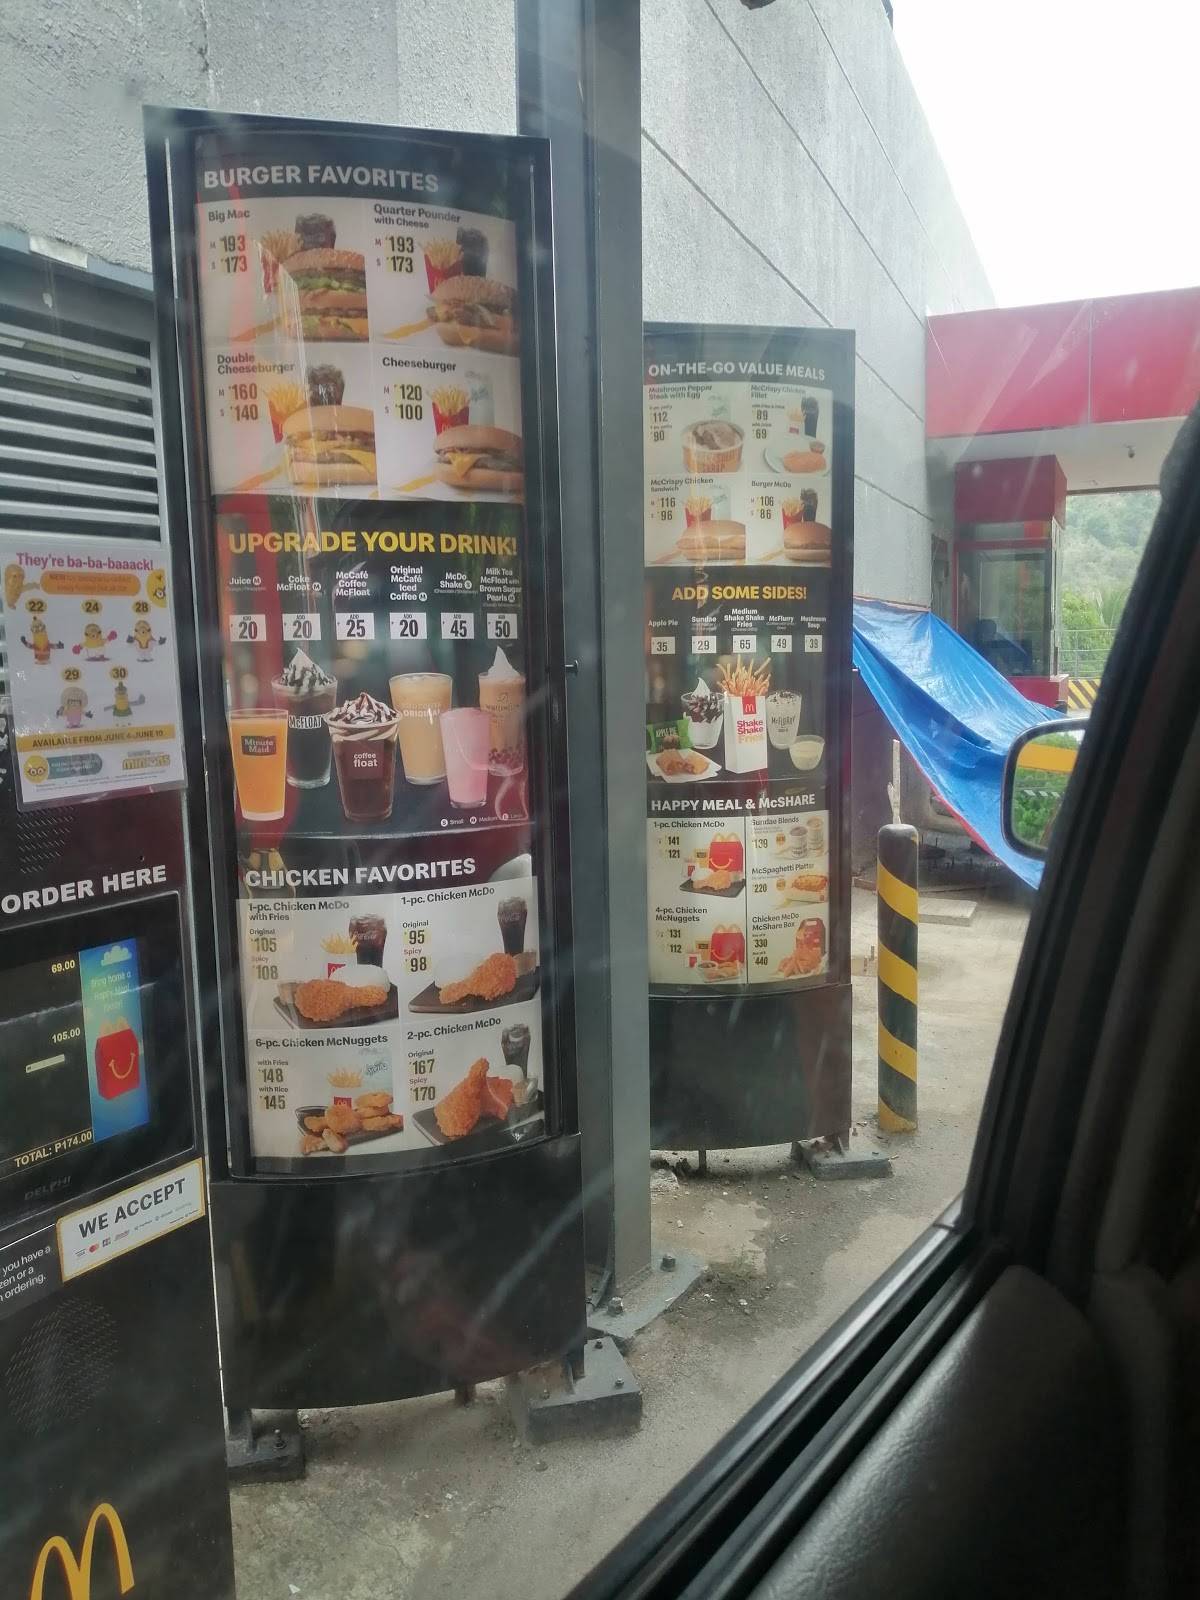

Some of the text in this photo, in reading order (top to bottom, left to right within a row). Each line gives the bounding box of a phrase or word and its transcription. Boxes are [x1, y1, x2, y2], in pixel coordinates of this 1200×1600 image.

[204, 165, 439, 192] BURGER FAVORITES
[208, 209, 250, 223] Big Mac
[373, 204, 461, 223] Quarter Pounder
[374, 216, 430, 229] with Cheese
[222, 235, 247, 251] 193
[388, 237, 414, 253] 193
[224, 256, 248, 273] 173
[390, 257, 413, 273] 173
[217, 353, 255, 364] Double
[382, 357, 457, 372] Cheeseburger
[218, 362, 295, 375] Cheeseburger
[648, 362, 825, 380] ON-THE-GO VALUE MEALS
[232, 383, 258, 400] 160
[399, 384, 422, 401] 120
[234, 405, 259, 421] 140
[399, 405, 423, 421] 100
[653, 412, 668, 422] 112
[651, 477, 714, 488] McCrispy Chicken
[751, 480, 773, 489] Burger
[660, 497, 675, 508] 116
[660, 511, 673, 521] 96
[229, 532, 518, 555] UPGRADE YOUR DRINK!
[17, 552, 154, 571] They're ba-ba-baaack!
[336, 571, 369, 580] McCafé
[390, 566, 423, 575] Original
[446, 572, 467, 580] McDo
[486, 568, 513, 576] Milk Tea
[229, 576, 251, 585] Juice
[288, 575, 310, 583] Coke
[339, 579, 367, 588] Coffee
[391, 574, 422, 583] McCafé
[480, 576, 508, 584] McFloat
[277, 583, 310, 591] McFloat
[399, 583, 417, 592] Iced
[440, 581, 463, 589] Shake
[336, 588, 370, 597] McFloat
[390, 592, 417, 601] Coffee
[487, 594, 507, 602] Pearls
[672, 586, 807, 601] ADD SOME SIDES!
[28, 601, 45, 613] 22
[85, 602, 99, 613] 24
[135, 602, 149, 613] 28
[648, 619, 666, 627] Apple
[769, 615, 794, 623] McFlurry
[239, 621, 258, 639] 20
[293, 620, 312, 638] 20
[346, 619, 366, 637] 25
[400, 620, 419, 637] 20
[450, 620, 468, 637] 45
[495, 621, 511, 638] 50
[656, 641, 668, 652] 35
[697, 640, 710, 650] 29
[739, 639, 751, 650] 65
[776, 638, 787, 648] 49
[64, 669, 80, 681] 29
[112, 668, 127, 679] 30
[737, 720, 764, 729] Shake
[737, 727, 764, 736] Shake
[32, 735, 103, 748] AVAILABLE FROM
[354, 752, 377, 760] coffee
[354, 758, 378, 768] float
[651, 794, 815, 811] HAPPY MEAL & McSHARE
[668, 836, 680, 845] 141
[668, 850, 680, 859] 121
[245, 858, 476, 887] CHICKEN FAVORITES
[752, 865, 794, 875] McSpaghetti
[1, 865, 167, 914] ORDER HERE
[401, 887, 495, 905] 1-pc. Chicken McDo
[249, 901, 350, 913] 1-pc. Chicken McDo
[655, 907, 674, 915] 4-pc.
[249, 913, 290, 921] with Fries
[655, 915, 700, 923] McNuggets
[752, 915, 780, 923] Chicken
[402, 920, 429, 929] Original
[249, 928, 276, 936] Original
[408, 930, 425, 944] 95
[669, 929, 681, 938] 131
[254, 938, 277, 952] 105
[670, 944, 682, 953] 112
[404, 948, 422, 956] Spicy
[51, 960, 76, 973] 69.00
[410, 957, 427, 972] 98
[256, 965, 278, 980] 108
[51, 1027, 81, 1043] 105.00
[407, 1018, 501, 1040] 2-pc. Chicken McDo
[256, 1034, 388, 1049] 6-pc. Chicken McNuggets
[408, 1049, 434, 1058] Original
[412, 1059, 435, 1075] 167
[262, 1069, 284, 1083] 148
[409, 1077, 428, 1085] Spicy
[413, 1086, 436, 1101] 170
[264, 1095, 286, 1110] 145
[14, 1131, 92, 1168] TOTAL: P174.00
[25, 1176, 71, 1200] DELPHI
[78, 1213, 109, 1239] WE
[114, 1178, 186, 1223] ACCEPT
[2, 1246, 51, 1277] you have a
[16, 1267, 34, 1280] or a
[5, 1273, 47, 1299] ordering.
